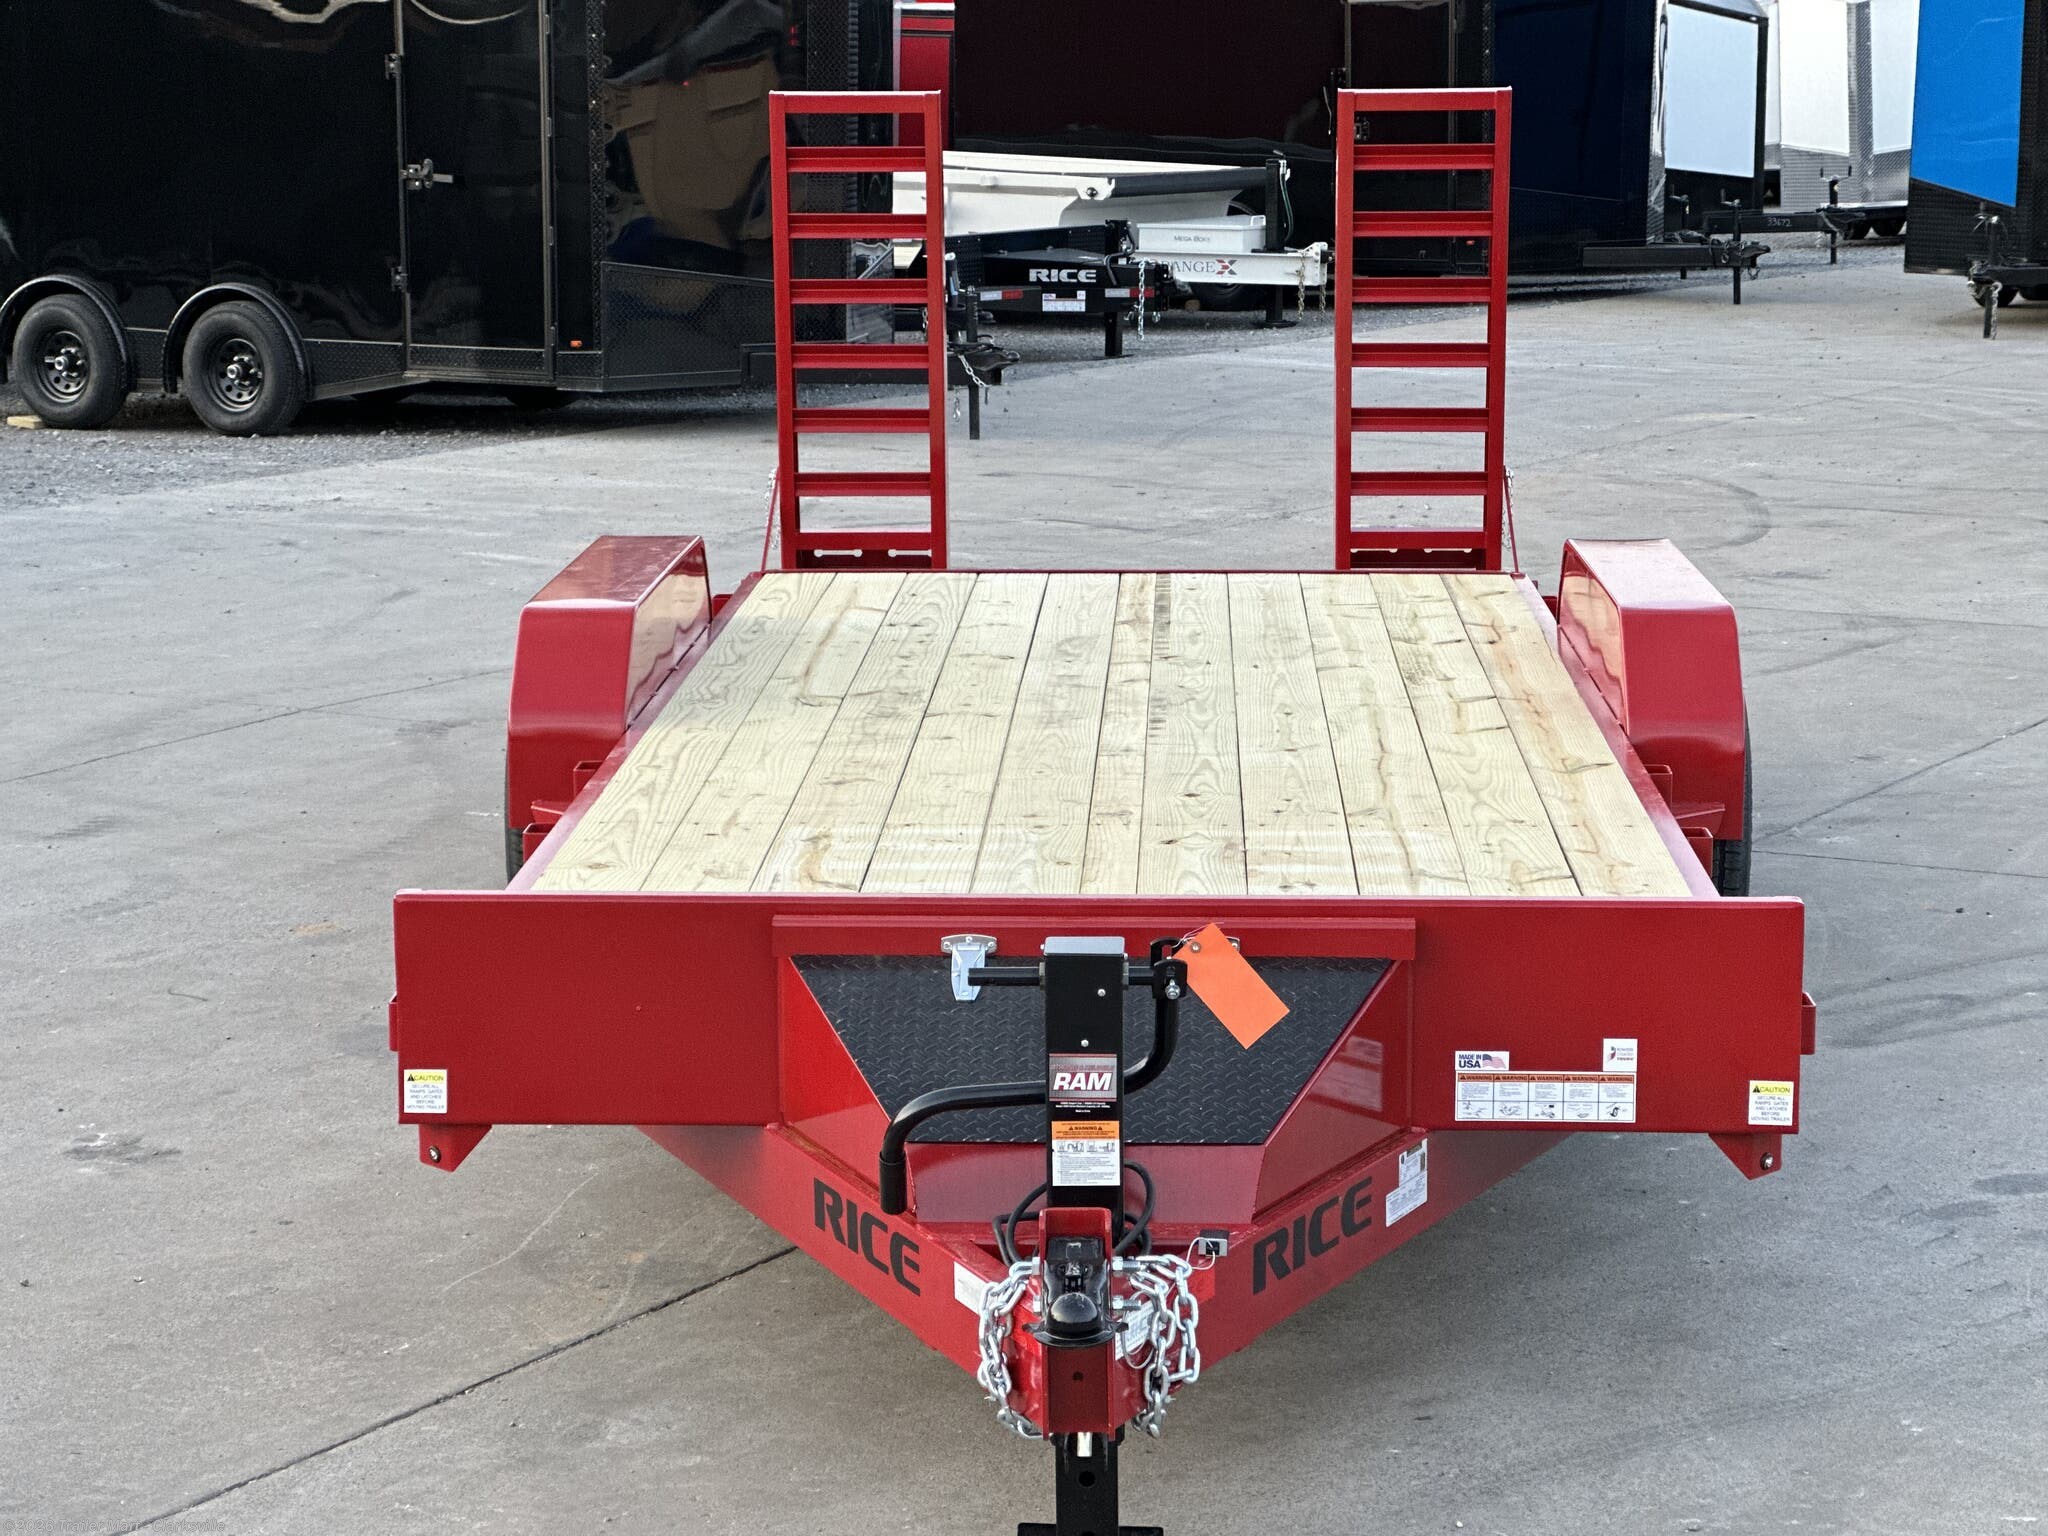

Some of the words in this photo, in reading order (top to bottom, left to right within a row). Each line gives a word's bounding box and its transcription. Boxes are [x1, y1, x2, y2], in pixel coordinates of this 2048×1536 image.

[1029, 268, 1096, 282] RICE
[1458, 1060, 1481, 1068] USA
[1053, 1072, 1112, 1091] RAM
[814, 1177, 920, 1297] RICE
[1253, 1176, 1372, 1295] RICE
